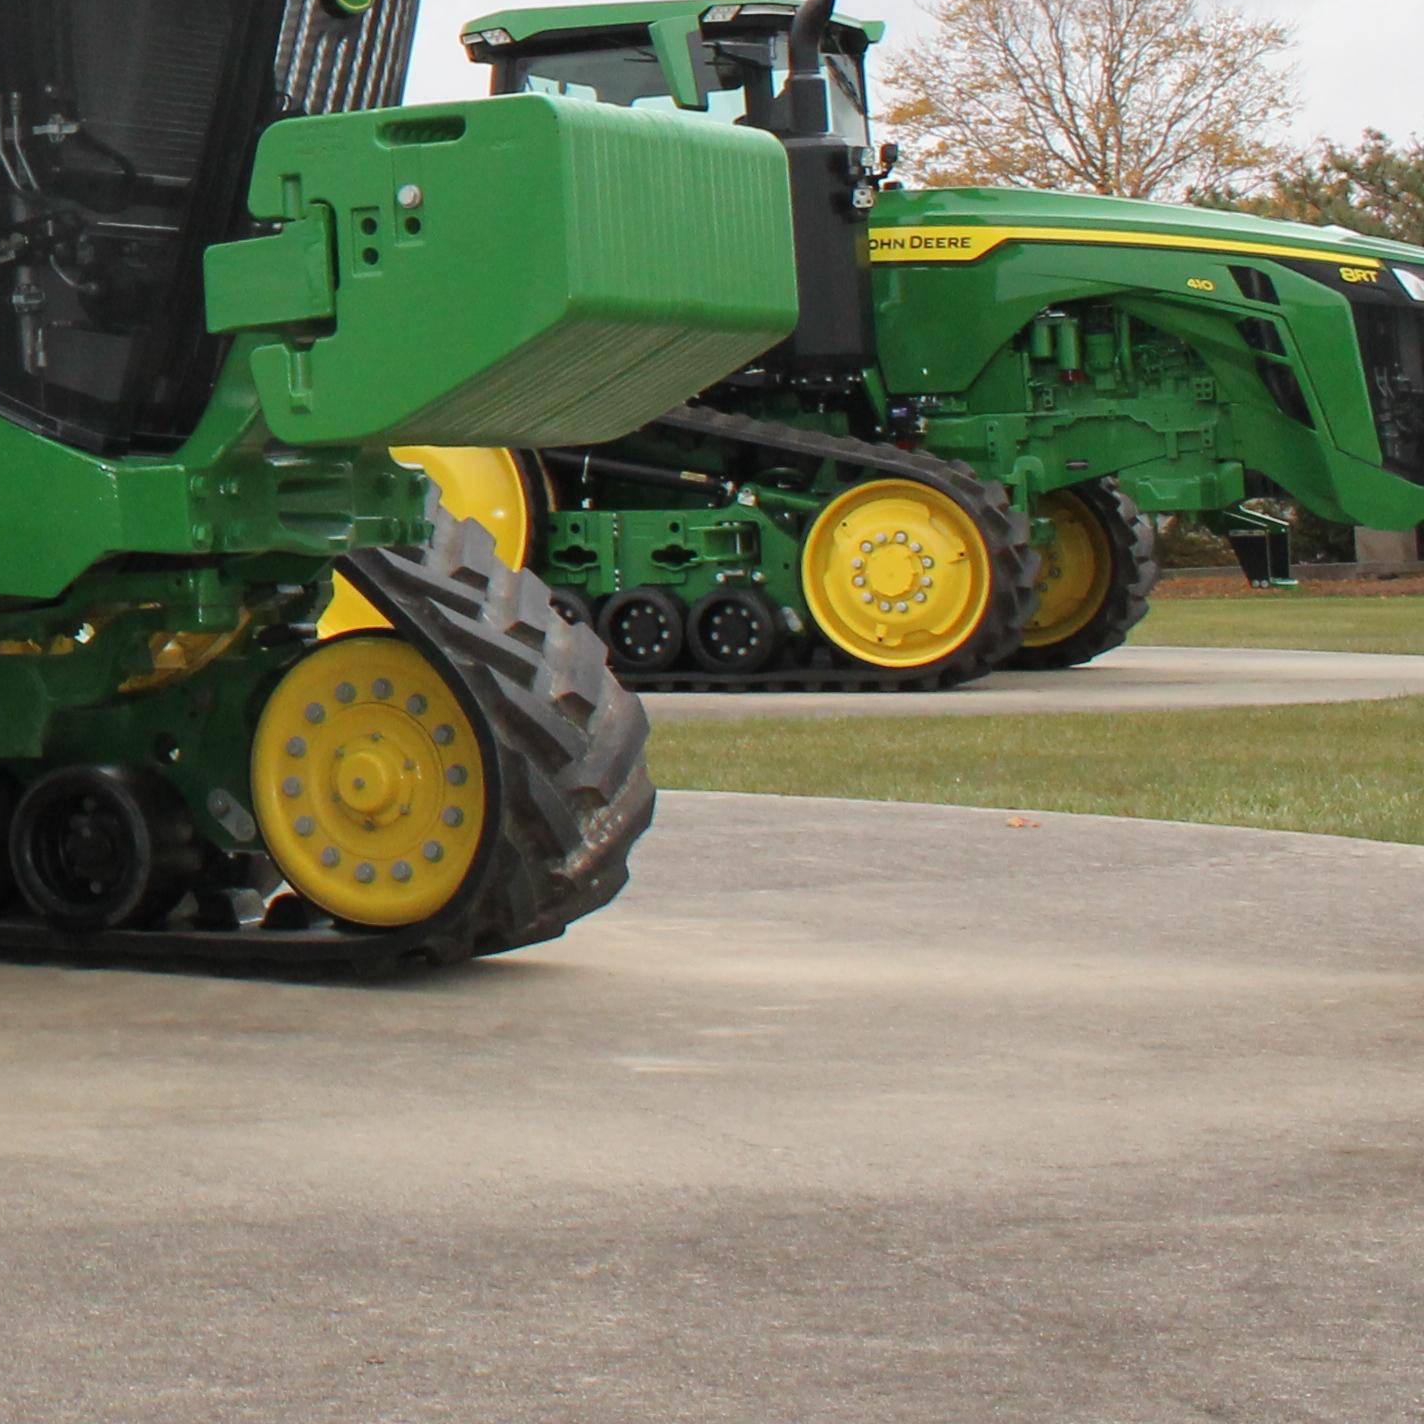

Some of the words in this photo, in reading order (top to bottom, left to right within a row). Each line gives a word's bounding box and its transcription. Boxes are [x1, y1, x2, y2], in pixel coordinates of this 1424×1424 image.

[868, 238, 905, 251] OHN
[910, 235, 971, 250] DEERE
[1338, 267, 1379, 283] 8RT
[1186, 277, 1215, 292] 410
